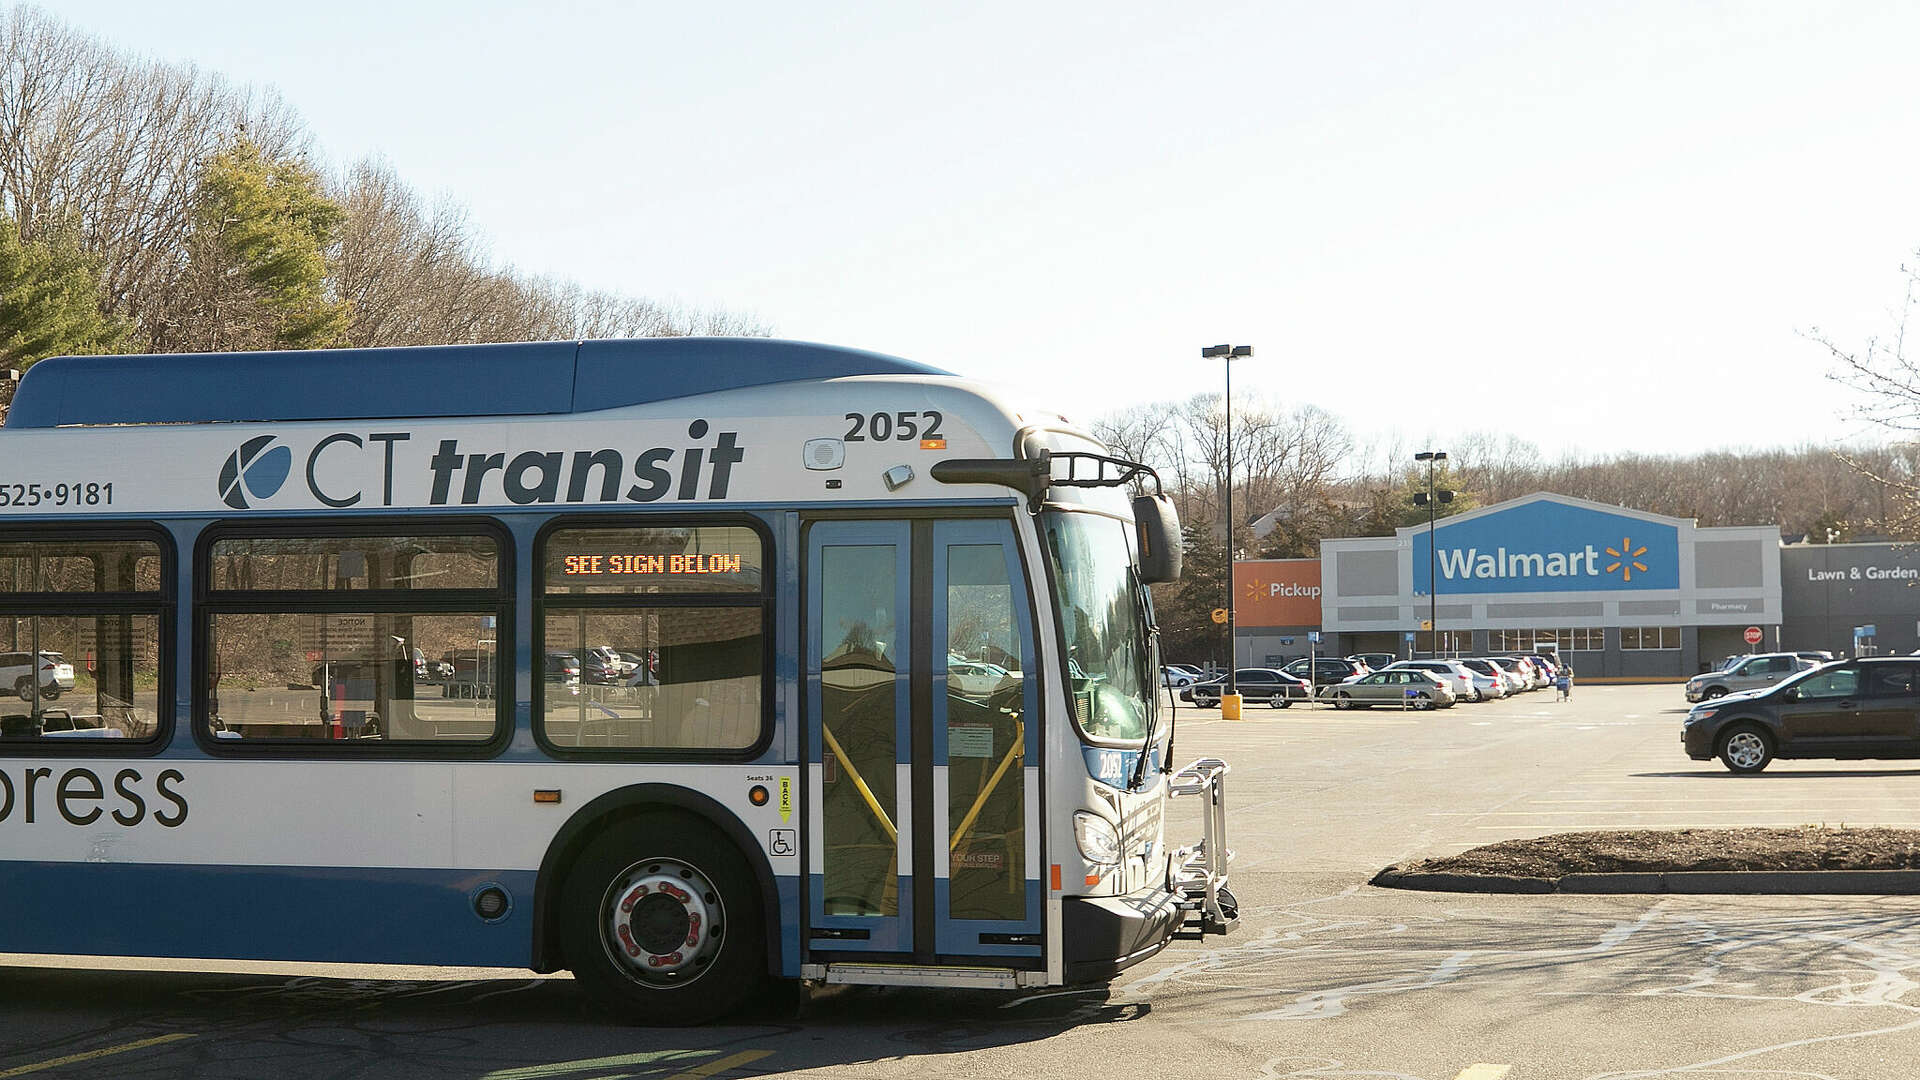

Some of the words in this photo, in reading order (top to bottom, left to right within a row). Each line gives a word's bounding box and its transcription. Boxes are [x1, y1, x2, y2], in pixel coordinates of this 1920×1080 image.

[844, 411, 943, 442] 2052
[306, 432, 411, 508] CT
[430, 418, 745, 506] transit
[564, 554, 603, 575] SEE
[608, 554, 664, 574] SIGN
[669, 554, 741, 574] BELOW
[1437, 545, 1599, 580] Walmart
[1808, 568, 1845, 581] Lawn
[1849, 566, 1861, 580] &
[1866, 566, 1918, 580] Garden
[1270, 583, 1321, 600] Pickup
[1711, 603, 1748, 612] Pharmacy
[1746, 632, 1761, 640] STOP
[0, 767, 189, 828] ress
[977, 854, 999, 863] STEP
